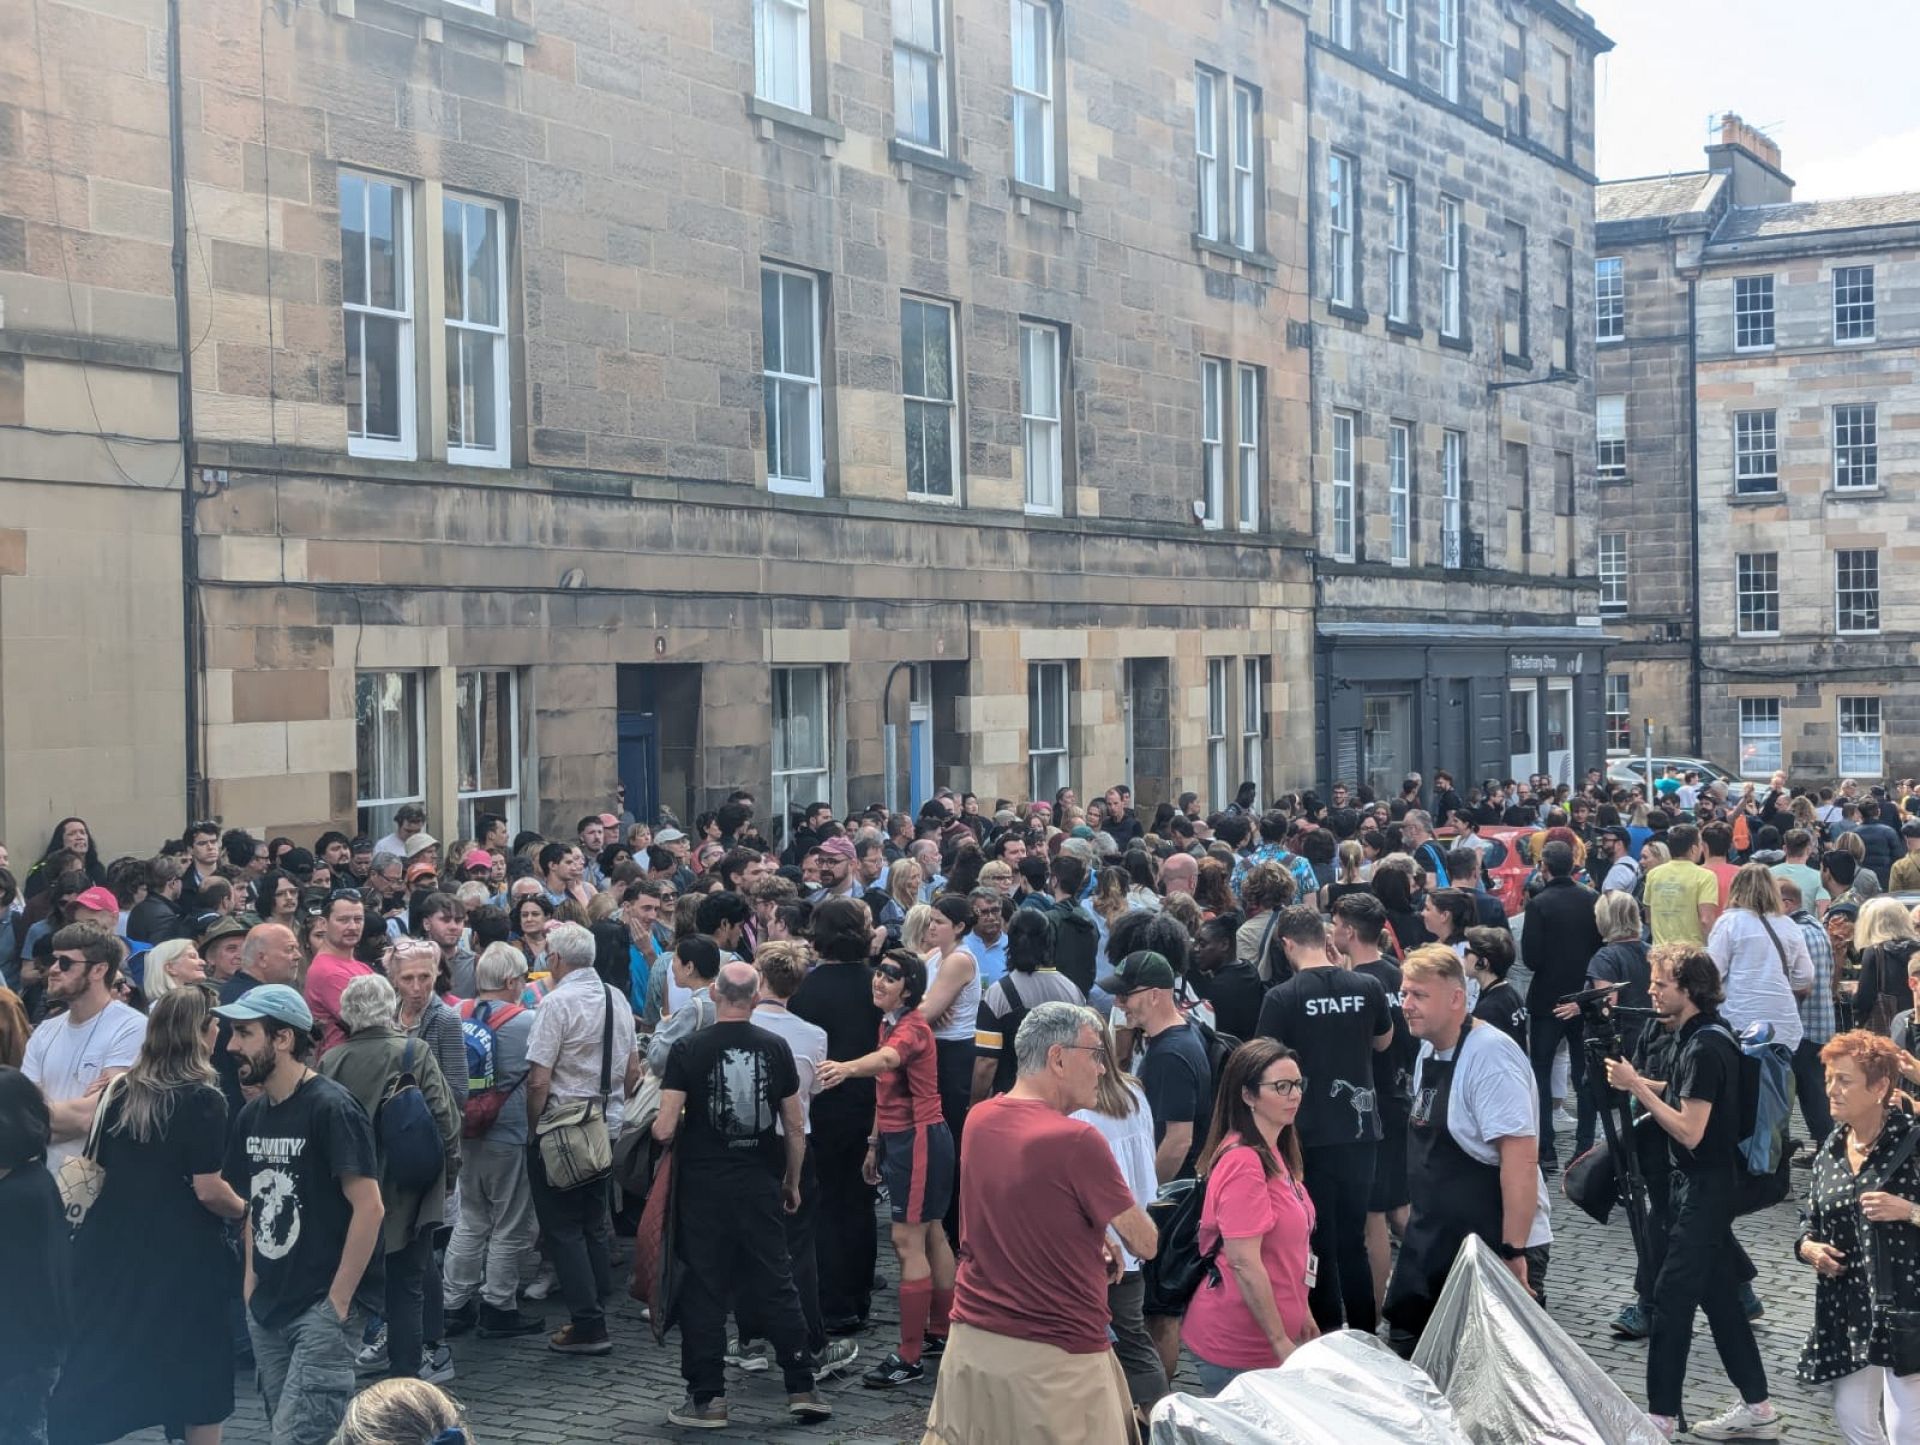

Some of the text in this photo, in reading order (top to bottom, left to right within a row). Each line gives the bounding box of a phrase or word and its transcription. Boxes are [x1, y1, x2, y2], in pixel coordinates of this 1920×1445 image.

[1543, 654, 1557, 672] Shop
[1305, 996, 1365, 1016] STAFF
[1385, 991, 1405, 1008] TAF
